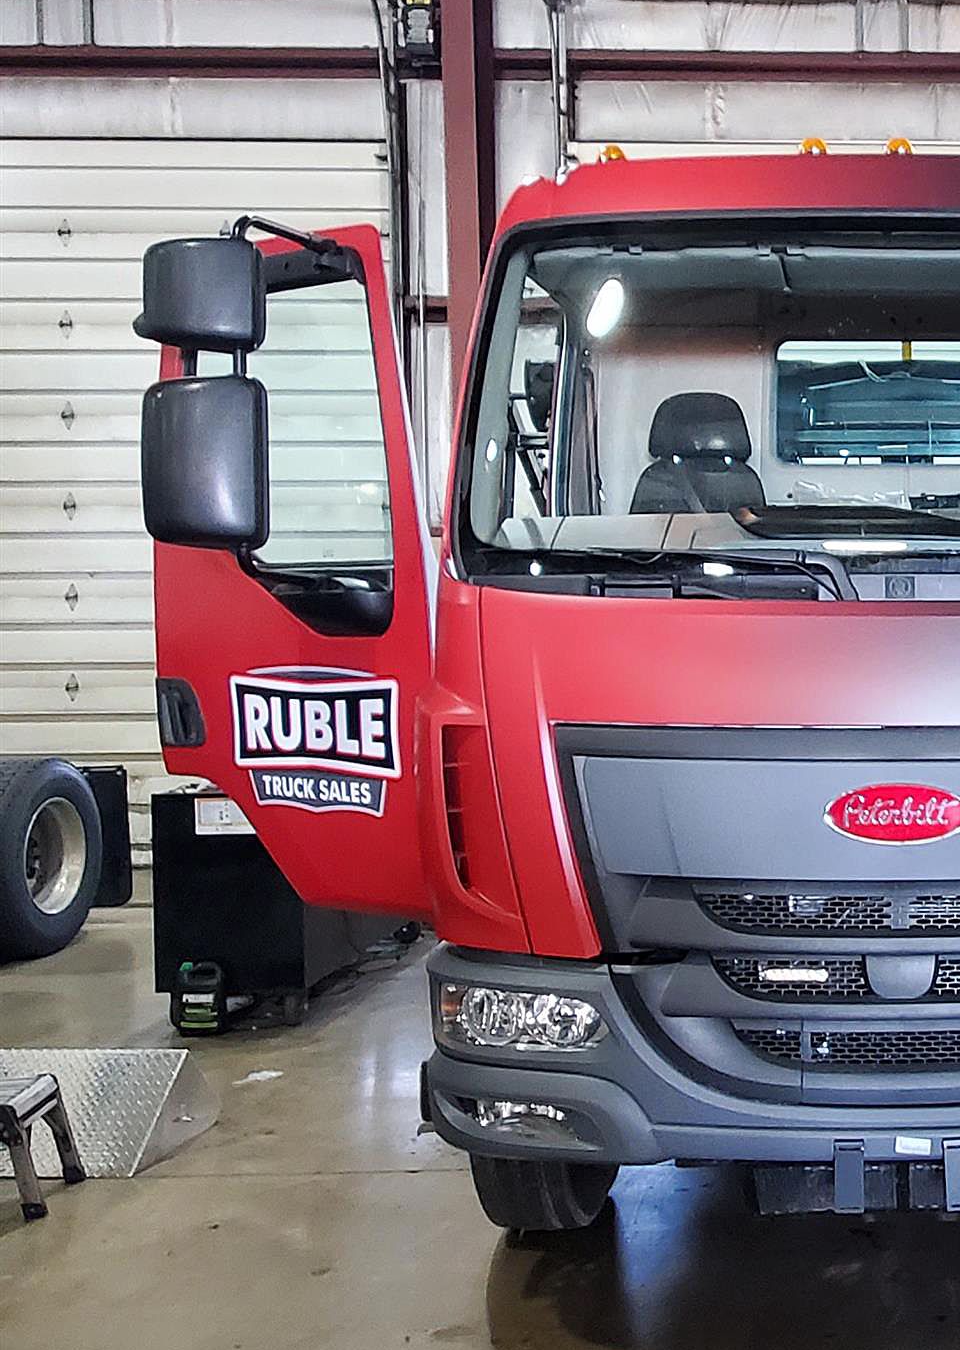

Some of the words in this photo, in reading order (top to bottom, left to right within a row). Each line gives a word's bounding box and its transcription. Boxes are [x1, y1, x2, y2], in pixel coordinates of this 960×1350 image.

[243, 693, 386, 760] RUBLE
[261, 774, 317, 800] TRUCK
[318, 779, 372, 805] SALES
[843, 794, 960, 828] Peterbilt
